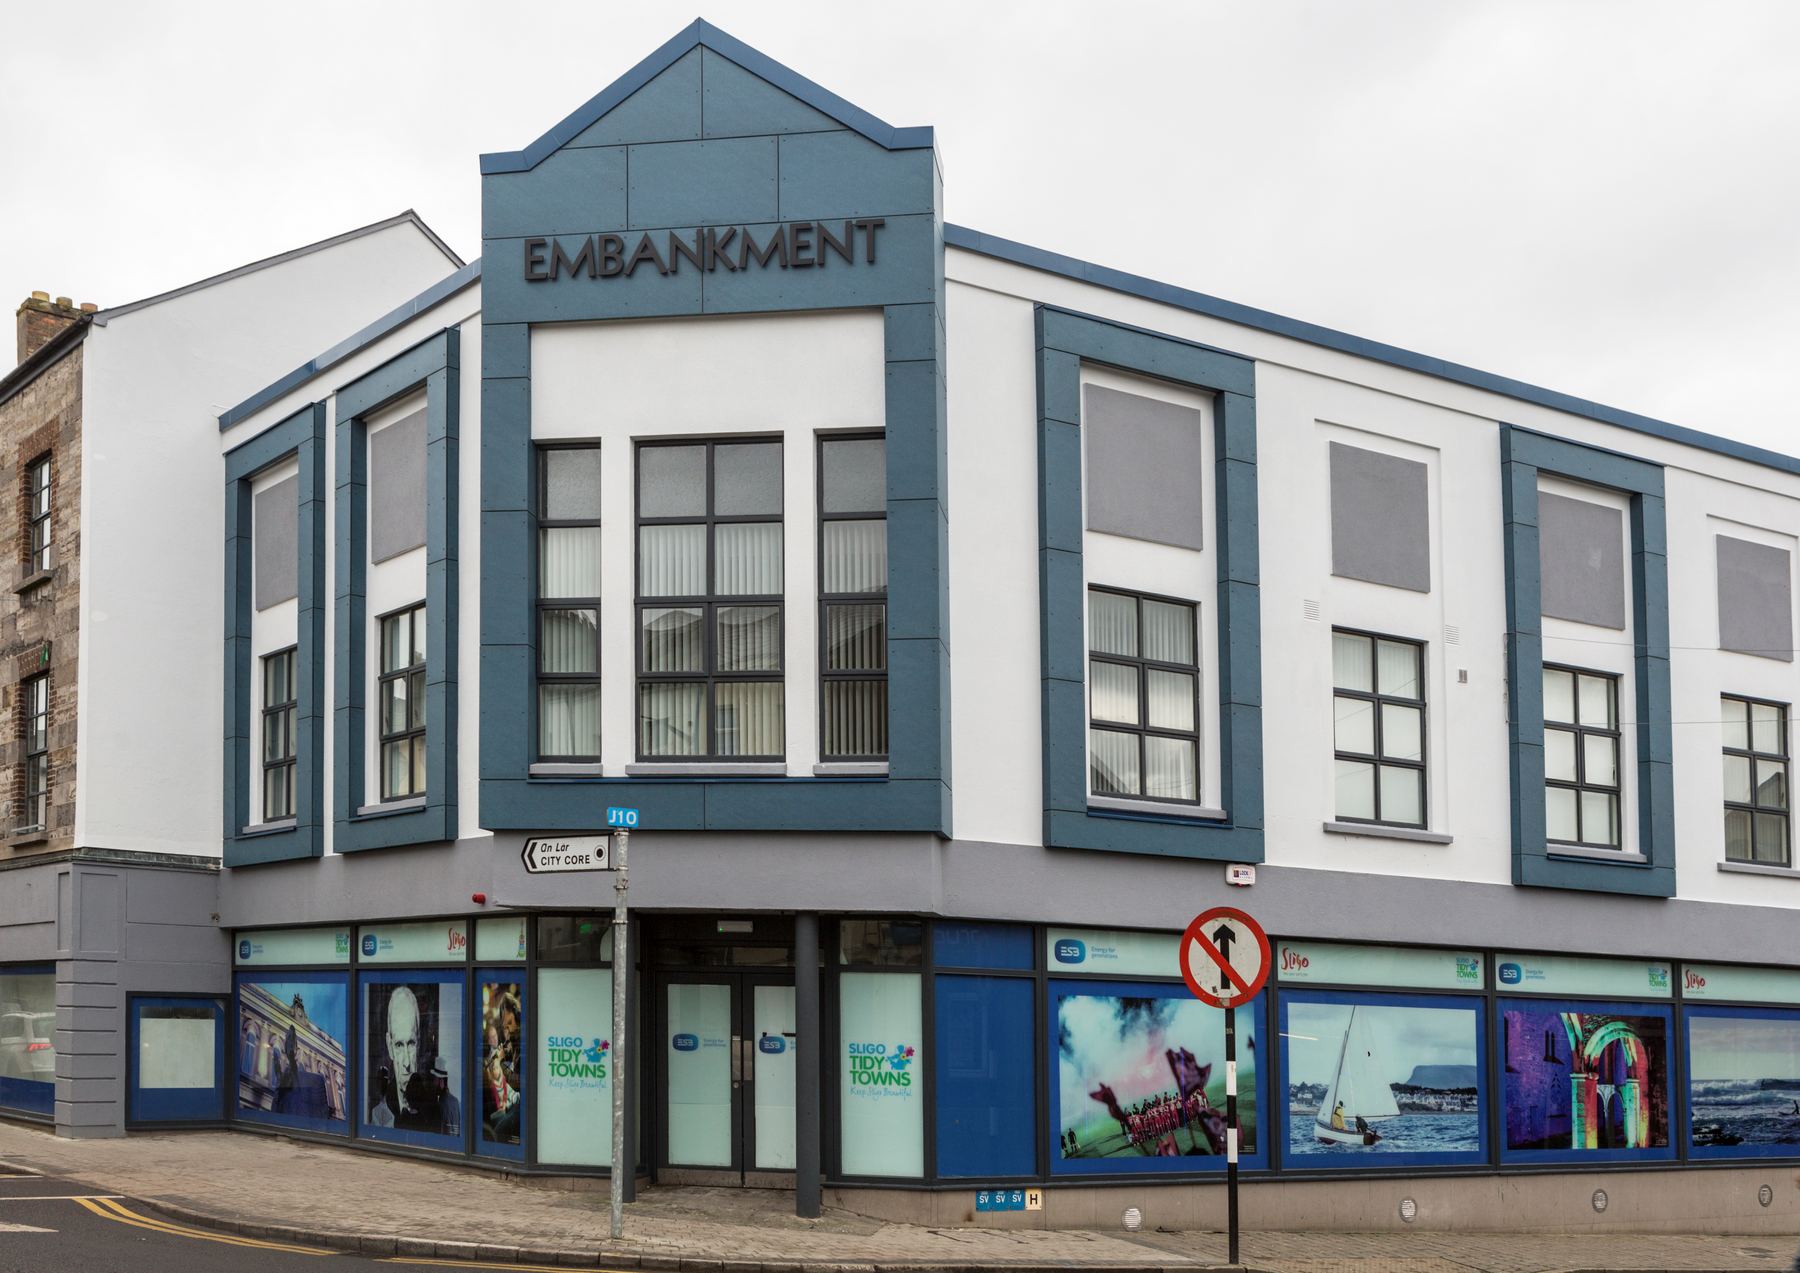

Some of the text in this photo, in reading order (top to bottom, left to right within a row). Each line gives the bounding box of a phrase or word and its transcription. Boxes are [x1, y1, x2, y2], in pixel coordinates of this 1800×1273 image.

[524, 218, 885, 281] EMBANKMENT
[609, 810, 637, 824] J10
[541, 855, 590, 866] CITY CORE
[1060, 946, 1080, 957] ESB
[1281, 946, 1309, 971] Sligo
[1456, 970, 1478, 979] TOWNS
[1503, 968, 1517, 978] ESB
[1685, 969, 1706, 989] Sligo
[548, 1037, 583, 1047] SLIGO
[849, 1043, 886, 1054] SLIGO
[548, 1049, 582, 1063] TIDY
[849, 1056, 885, 1070] TIDY
[548, 1064, 606, 1078] TOWNS
[849, 1071, 911, 1086] TOWNS
[979, 1194, 1022, 1203] SV SV SV
[1029, 1194, 1038, 1205] H
